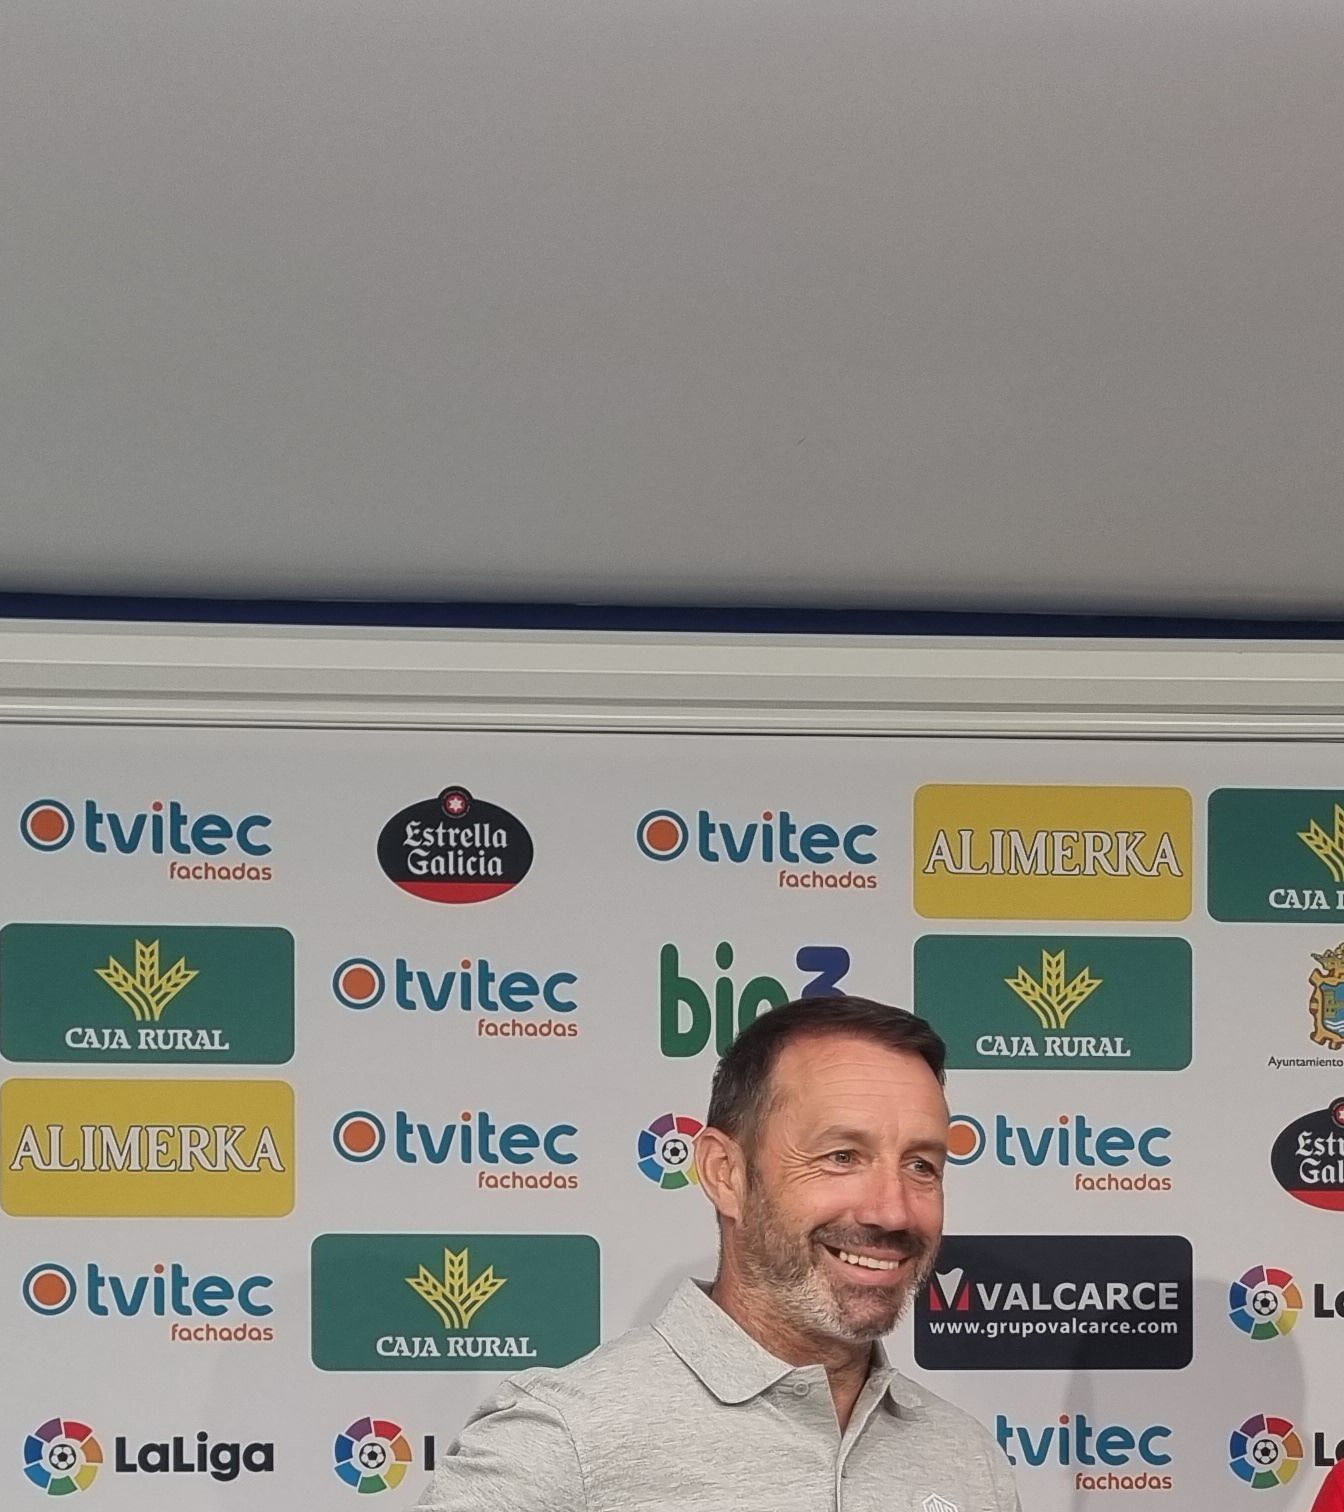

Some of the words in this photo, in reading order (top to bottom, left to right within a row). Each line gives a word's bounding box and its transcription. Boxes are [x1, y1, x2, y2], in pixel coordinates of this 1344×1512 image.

[86, 800, 271, 856] tvitec
[404, 821, 507, 848] Estrella
[699, 811, 877, 864] tvitec
[408, 849, 503, 875] Galicia
[922, 829, 1183, 877] ALIMERKA
[1269, 889, 1330, 910] CAJA
[396, 959, 577, 1012] tvitec
[66, 1028, 131, 1050] CAJA
[138, 1029, 229, 1049] RURAL
[977, 1036, 1038, 1057] CAJA
[1045, 1037, 1130, 1056] RURAL
[1268, 1056, 1343, 1069] Ayuntamiento
[9, 1124, 285, 1172] ALIMERKA
[397, 1111, 578, 1164] tvitec
[997, 1115, 1171, 1166] tvitec
[479, 1171, 577, 1188] fachadas
[1076, 1174, 1171, 1190] fachadas
[88, 1264, 273, 1316] tvitec
[976, 1283, 1178, 1310] VALCARCE
[930, 1318, 1177, 1337] www.grupovalcarce.com
[377, 1336, 441, 1358] CAJA
[447, 1337, 536, 1357] RURAL
[116, 1432, 274, 1481] LaLiga
